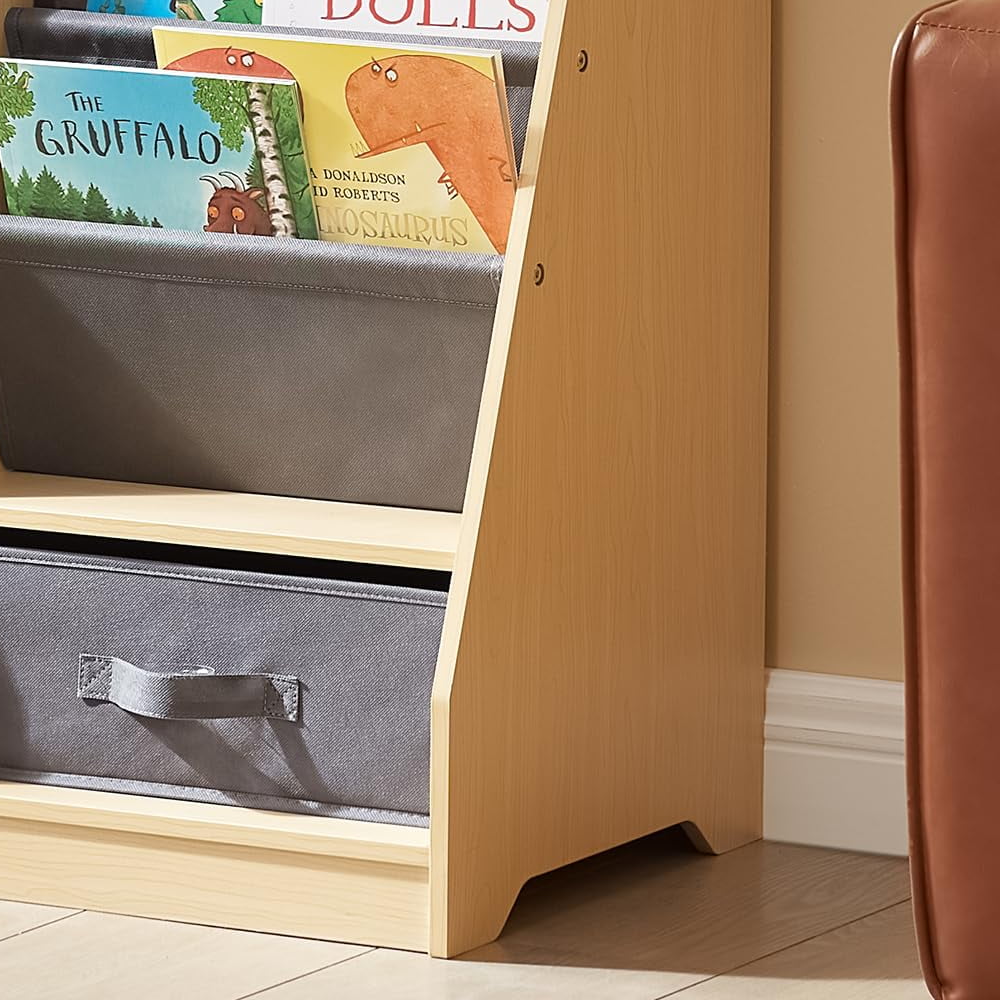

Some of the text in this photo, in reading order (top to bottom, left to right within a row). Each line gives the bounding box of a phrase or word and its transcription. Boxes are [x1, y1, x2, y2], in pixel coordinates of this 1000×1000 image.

[65, 92, 104, 112] THE
[35, 119, 221, 165] GRUFFALO
[324, 169, 406, 185] DONALDSON
[334, 188, 400, 203] ROBERTS
